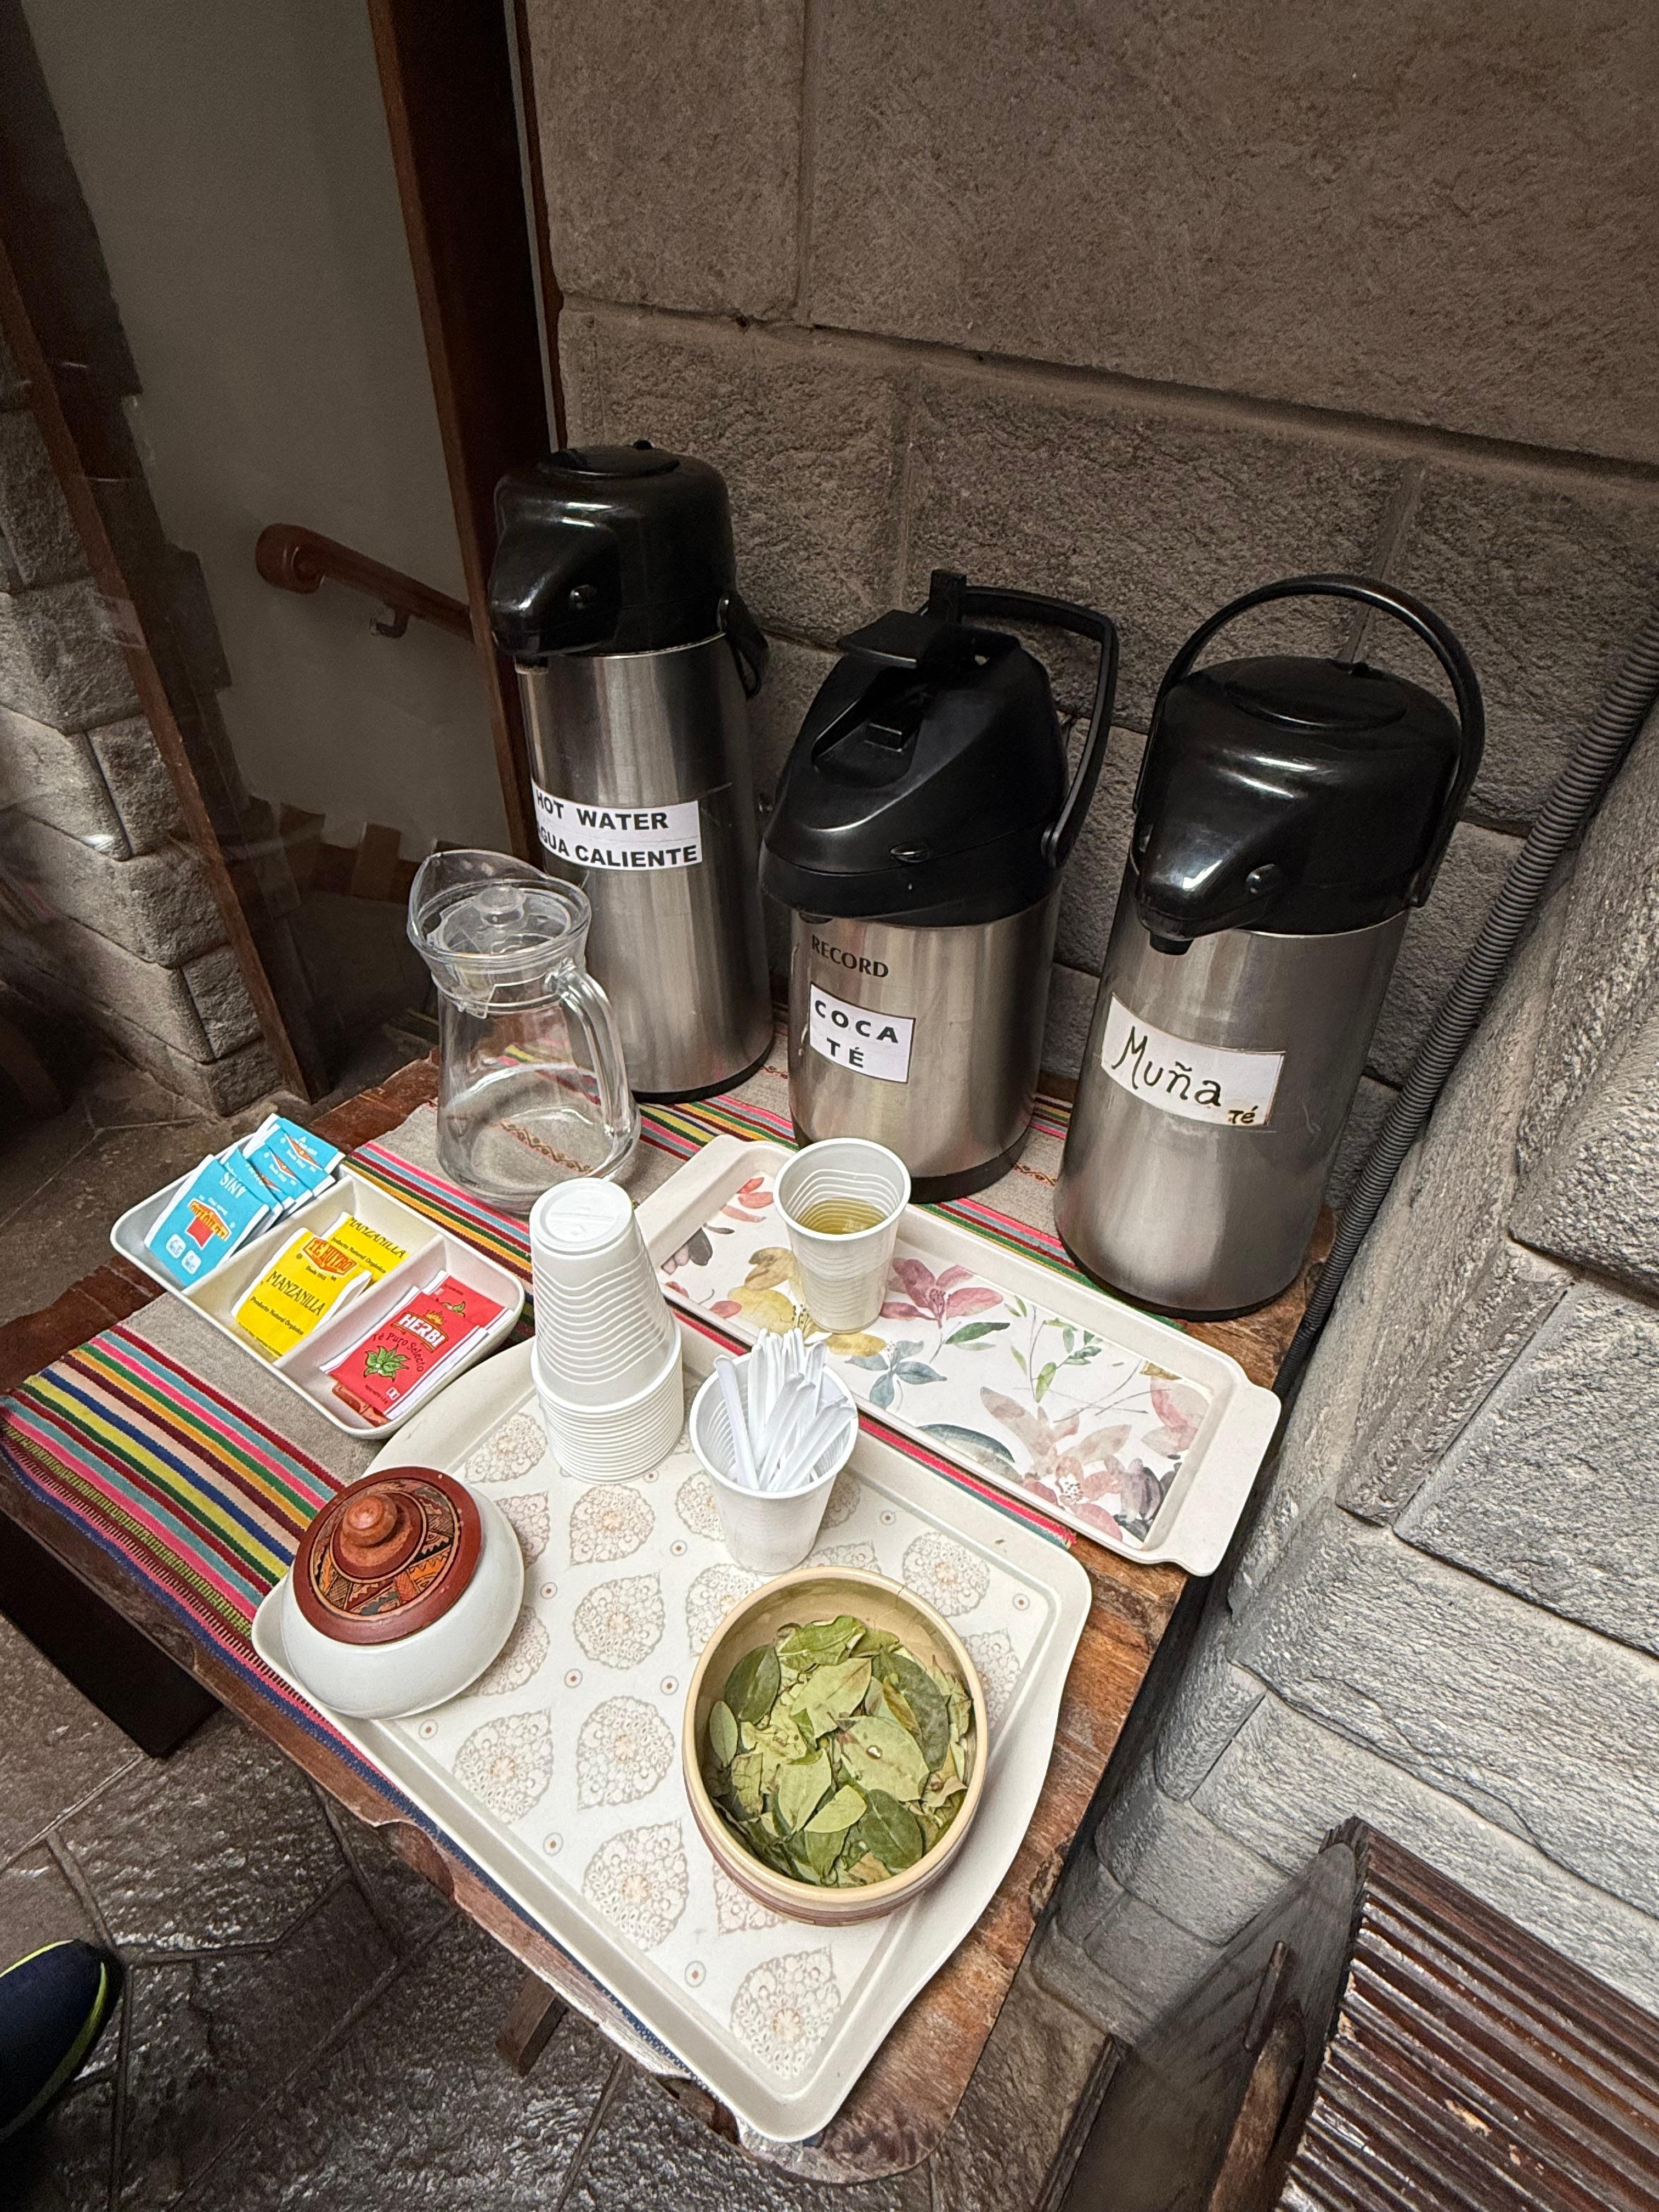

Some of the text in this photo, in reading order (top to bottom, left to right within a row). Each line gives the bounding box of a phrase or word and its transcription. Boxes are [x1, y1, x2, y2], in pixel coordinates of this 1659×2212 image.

[536, 789, 669, 831] HOT WATER
[575, 844, 697, 867] CALIENTE
[812, 934, 889, 978] RECORD
[815, 1000, 899, 1043] COCA
[826, 1037, 864, 1068] TÉ
[1111, 1026, 1222, 1107] Muña
[219, 1172, 247, 1199] ANIS
[266, 1270, 326, 1317] MANZANILLA
[398, 1313, 446, 1348] HERBI
[386, 1333, 408, 1346] Puro
[407, 1342, 426, 1372] Selecto
